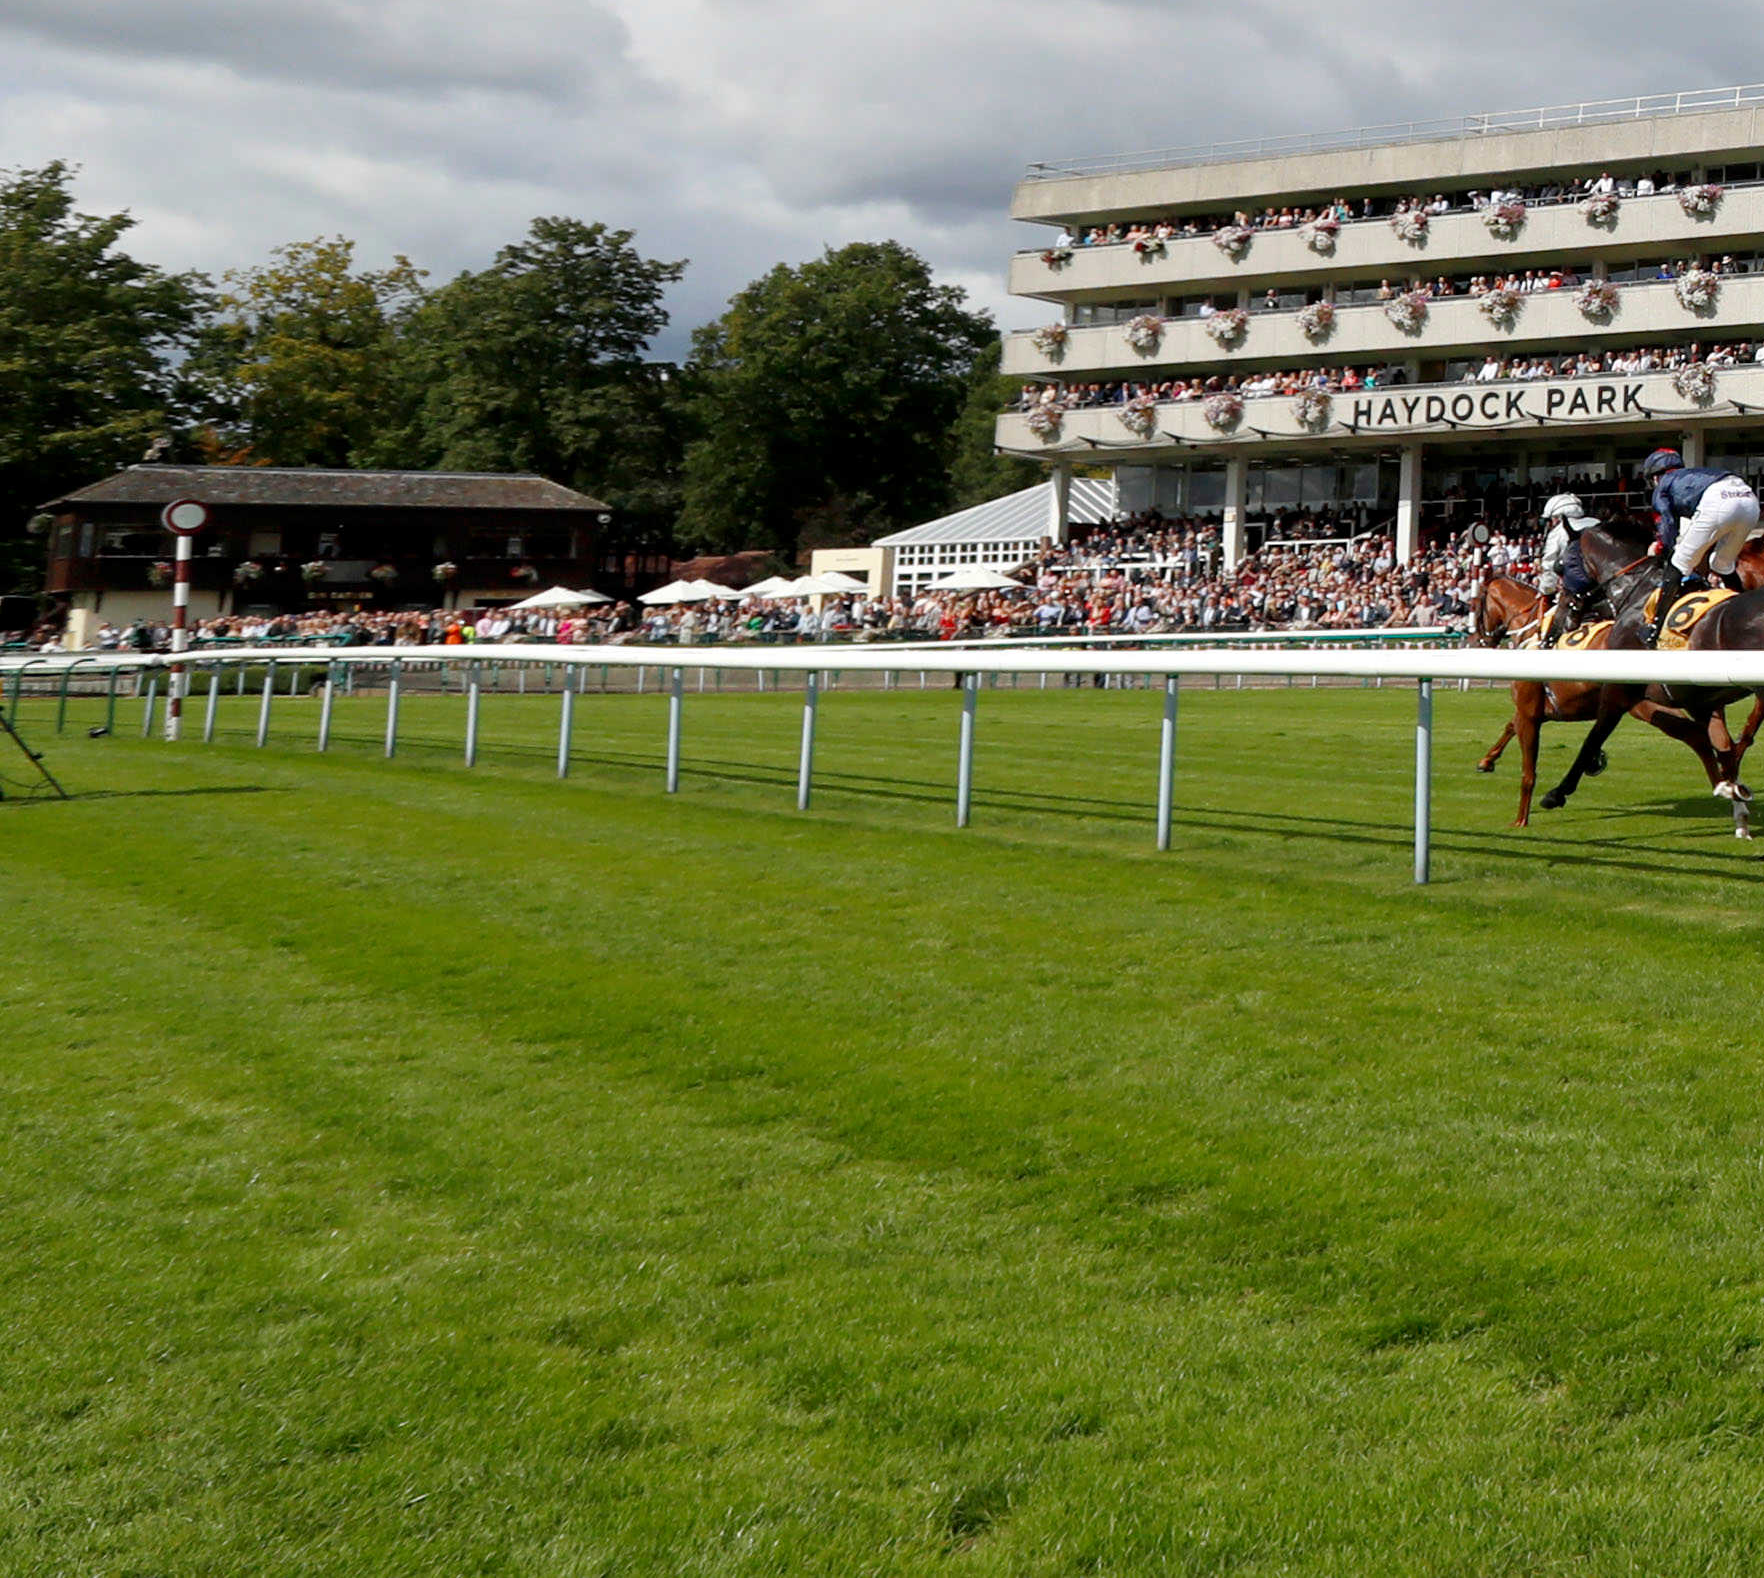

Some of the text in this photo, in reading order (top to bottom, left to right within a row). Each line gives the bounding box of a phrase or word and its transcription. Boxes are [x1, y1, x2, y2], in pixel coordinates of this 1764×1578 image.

[1353, 383, 1644, 426] HAYDOCK PARK
[1667, 596, 1710, 628] 6
